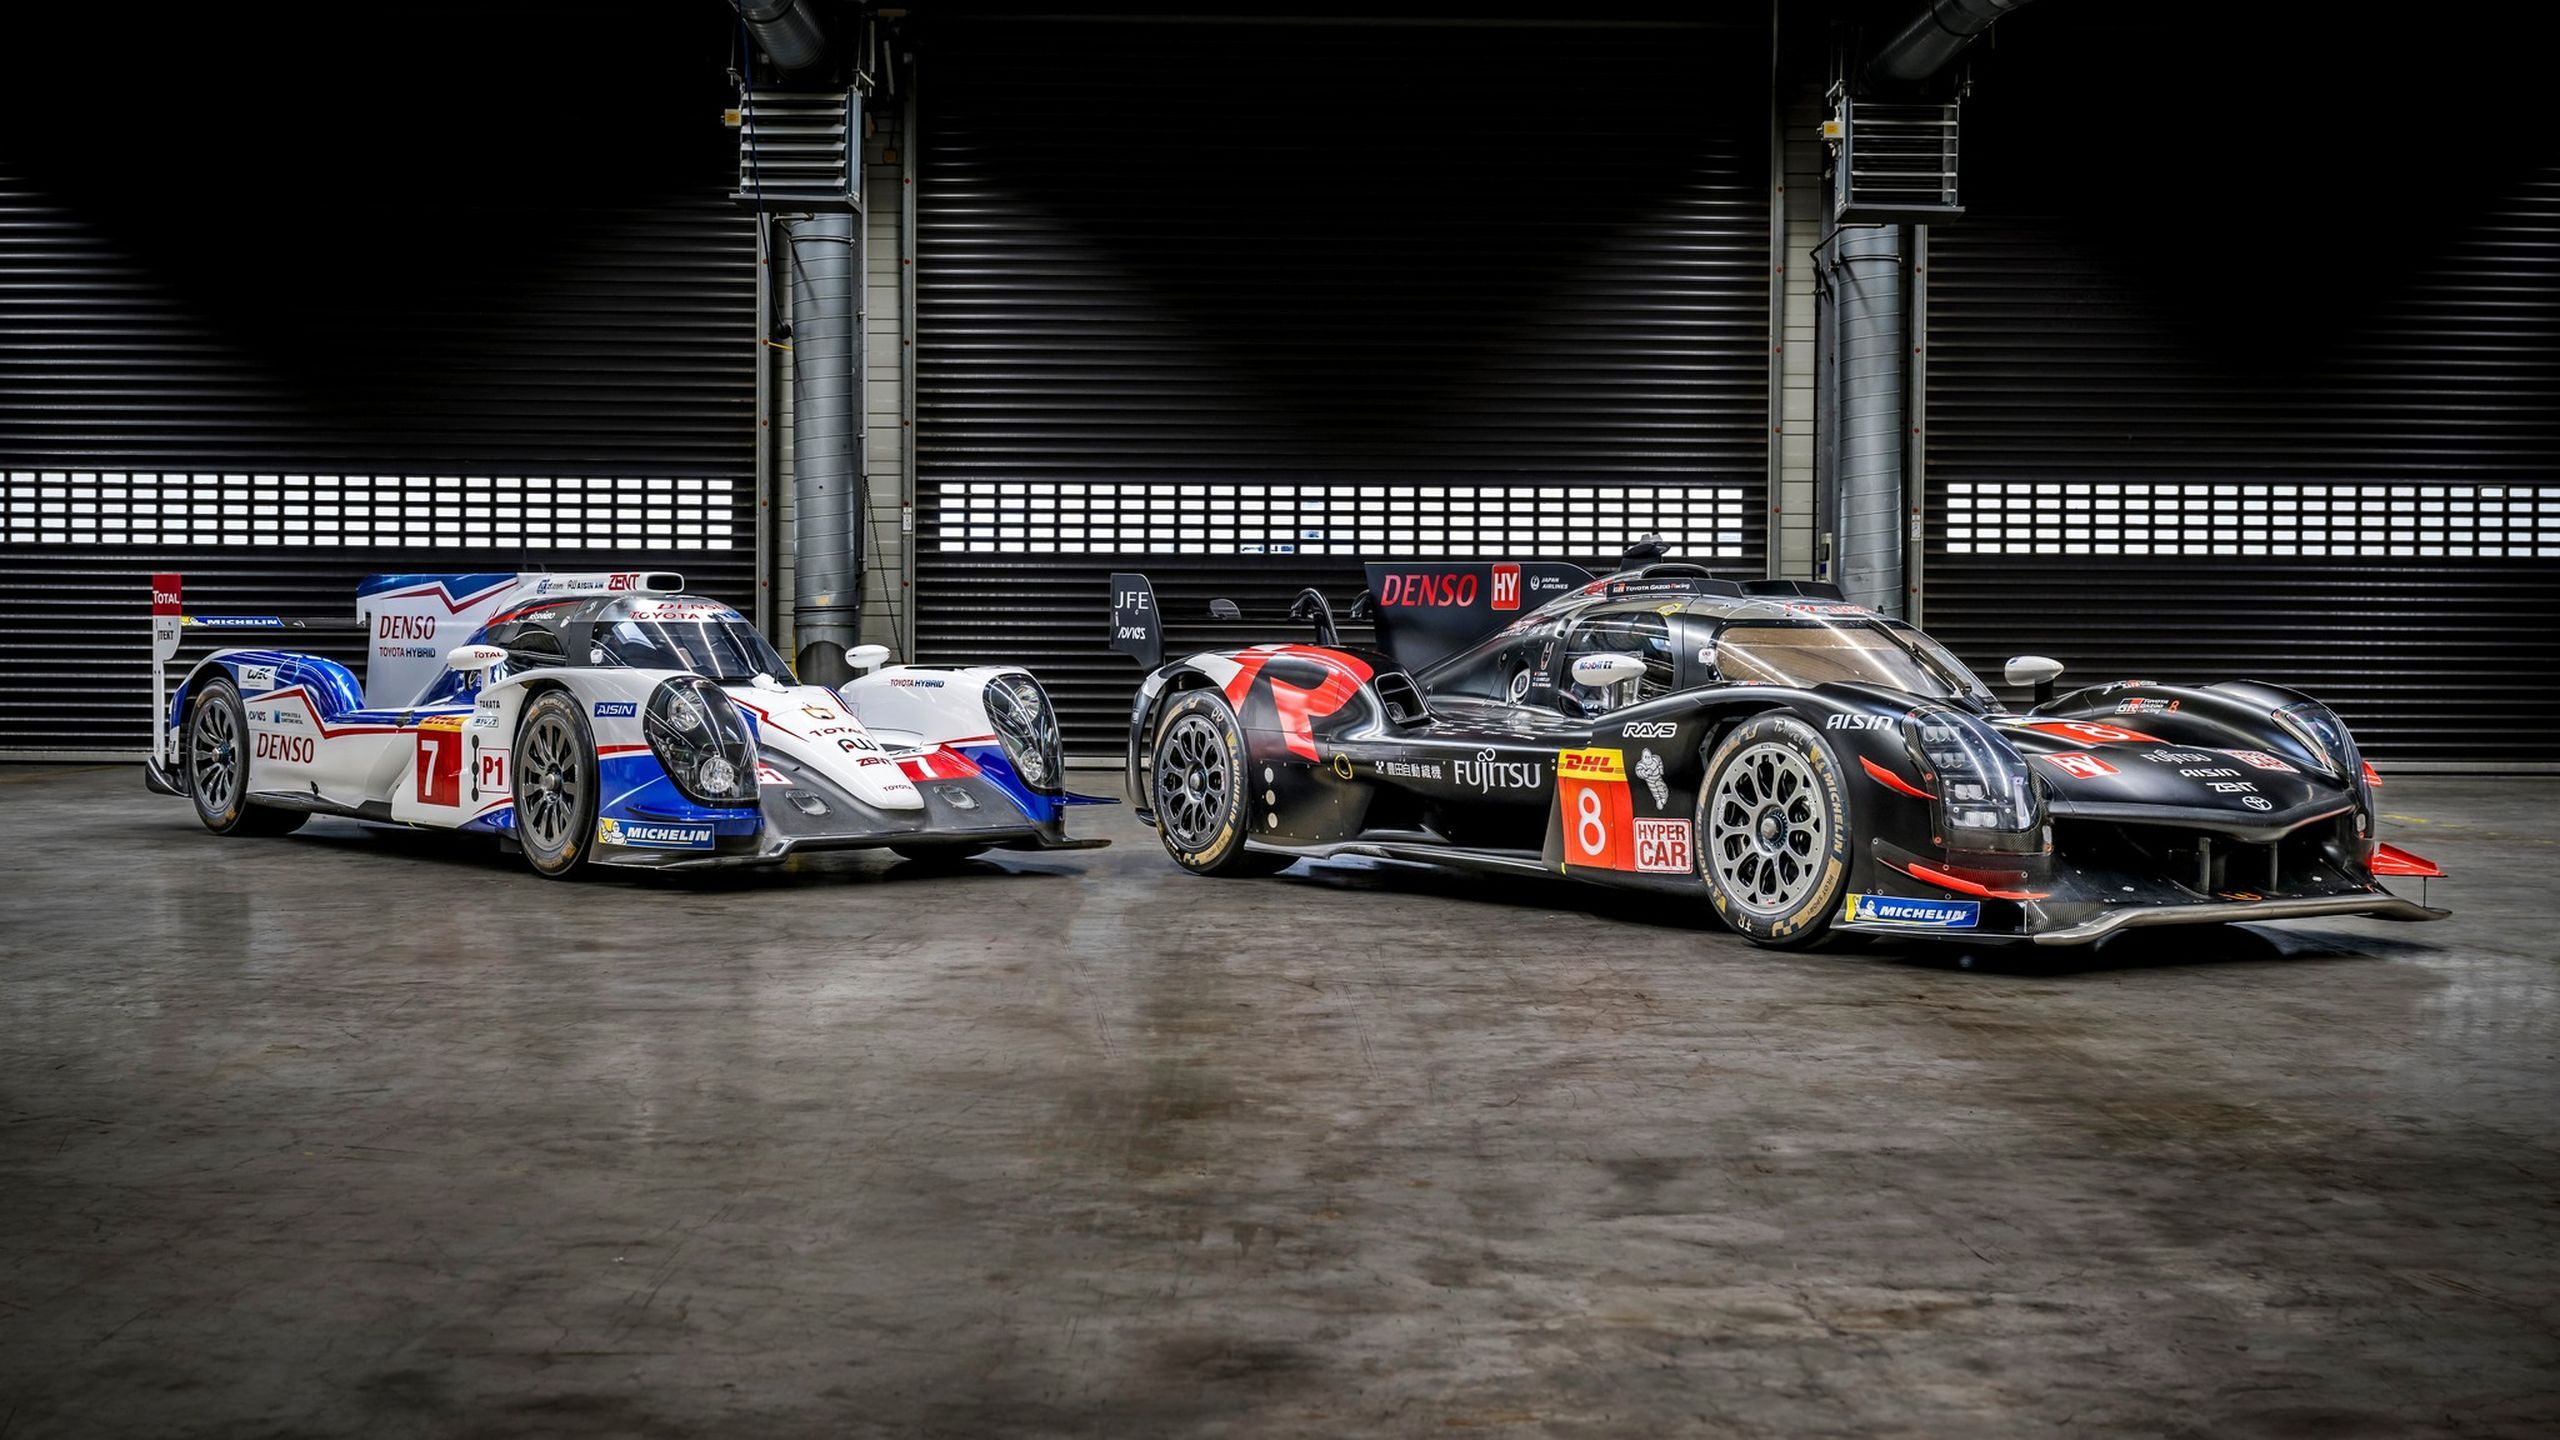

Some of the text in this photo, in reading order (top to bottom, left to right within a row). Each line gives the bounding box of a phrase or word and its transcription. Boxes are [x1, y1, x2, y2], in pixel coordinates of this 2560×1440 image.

[608, 574, 640, 591] ZENT
[1380, 574, 1478, 607] DENSO
[1493, 572, 1518, 602] HY
[153, 590, 180, 604] TOTAL
[1115, 591, 1149, 609] JFE
[629, 611, 701, 620] TOYOTA
[379, 615, 436, 640] DENSO
[379, 647, 436, 658] TOYOTA HYBRID
[473, 651, 504, 659] TOTAL
[890, 679, 945, 688] TOYOTA HYBRID
[597, 704, 635, 715] AISIN
[1623, 722, 1678, 739] RAYS
[1826, 714, 1895, 731] AISIN
[257, 732, 314, 764] DENSO
[421, 739, 503, 797] 7 P1
[1564, 753, 1615, 774] DHL
[1453, 758, 1542, 794] FUJITSU
[1229, 758, 1242, 823] MICHELIN
[1577, 787, 1606, 856] 8
[1823, 772, 1845, 855] MICHELIN
[626, 826, 711, 842] MICHELIN
[1638, 824, 1686, 841] HYPER
[1639, 840, 1687, 867] CAR
[1878, 904, 1968, 921] MICHELIN
